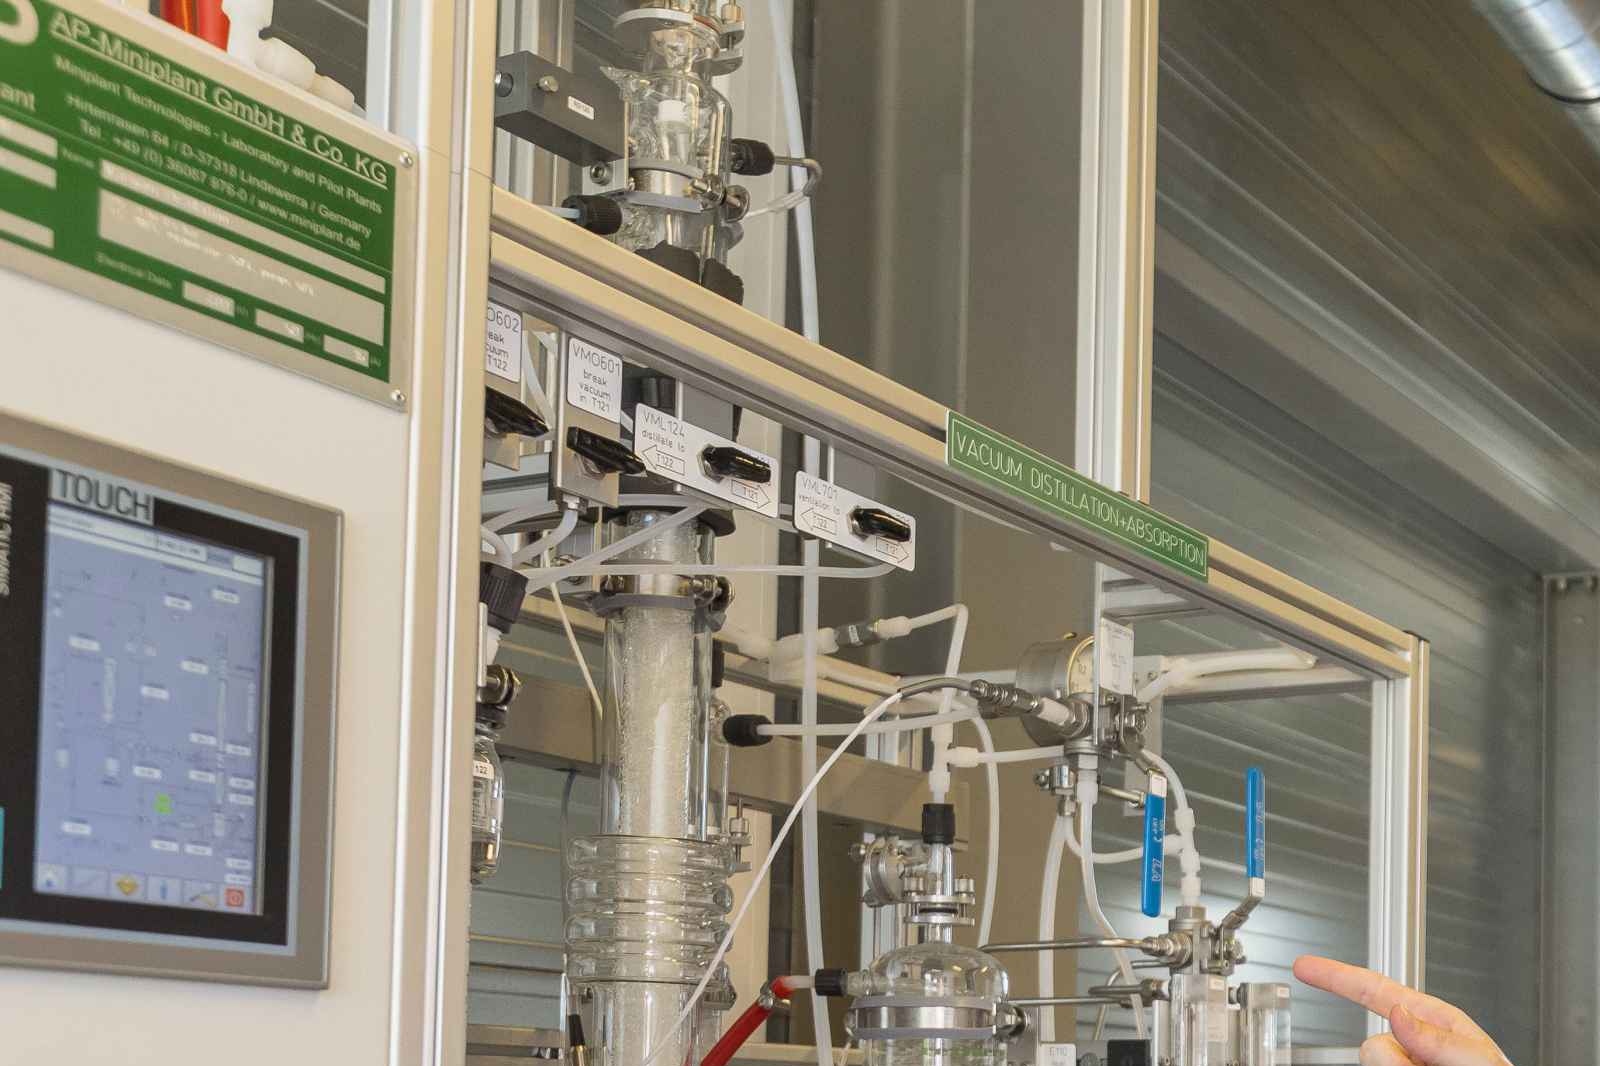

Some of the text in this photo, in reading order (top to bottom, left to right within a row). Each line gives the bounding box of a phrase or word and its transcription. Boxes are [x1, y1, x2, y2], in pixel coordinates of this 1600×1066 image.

[51, 10, 207, 99] AP-Miniplant
[213, 87, 284, 136] GmbH
[292, 123, 306, 148] &
[313, 133, 348, 167] Co.
[355, 153, 387, 185] KG
[122, 86, 211, 139] Technologies
[223, 133, 289, 174] Laboratory
[292, 165, 315, 185] and
[318, 176, 344, 198] Pilot
[346, 188, 382, 215] Plants
[257, 198, 360, 252] www.miniplant.de
[319, 205, 371, 240] Germany
[488, 306, 520, 333] O602
[578, 382, 611, 402] vacuum
[583, 369, 607, 386] break
[55, 468, 152, 522] TOUCH
[955, 431, 1205, 567] VACUUM DISTILLATION+ABSORPTION
